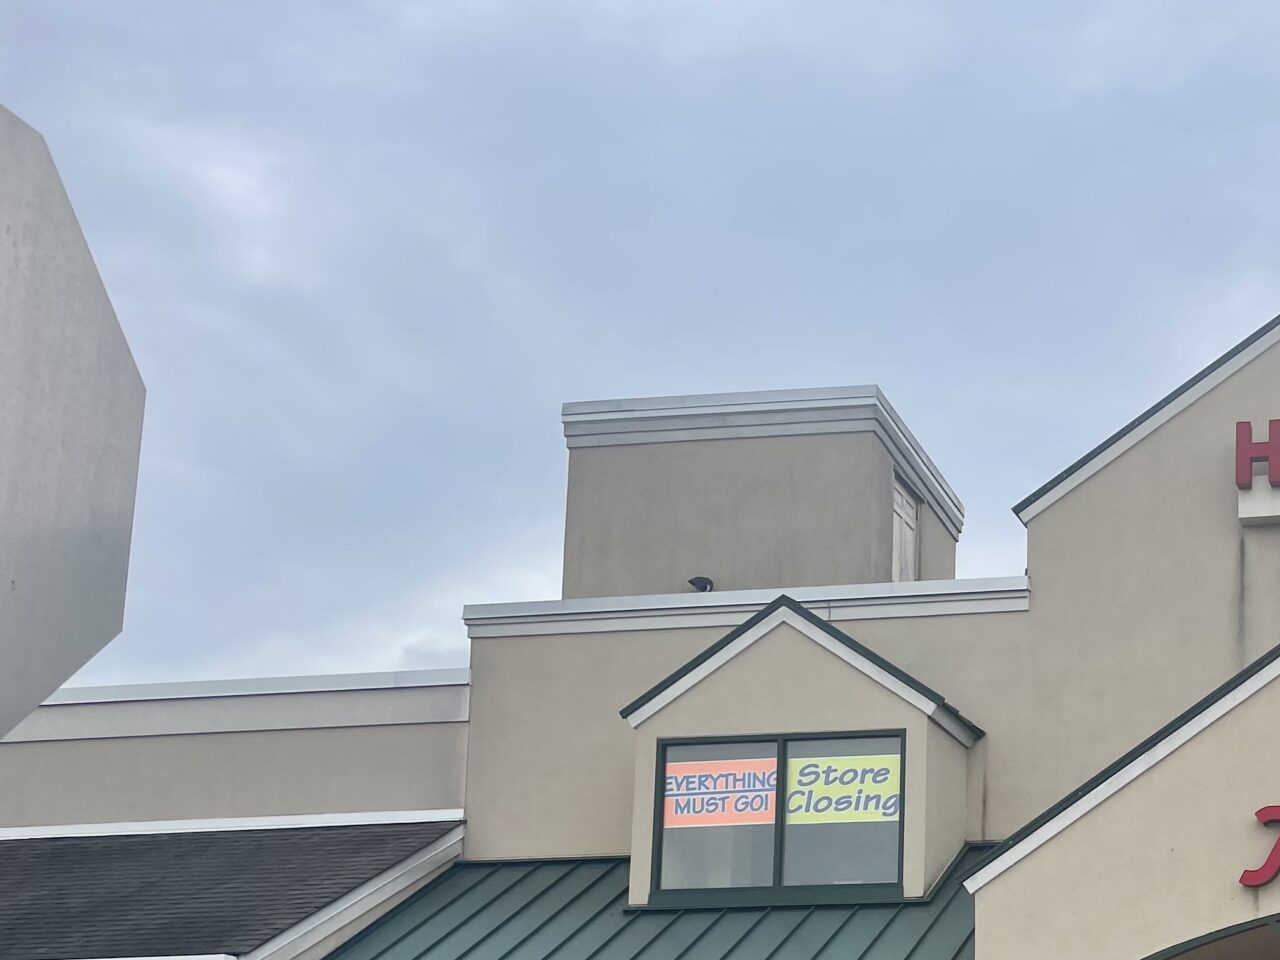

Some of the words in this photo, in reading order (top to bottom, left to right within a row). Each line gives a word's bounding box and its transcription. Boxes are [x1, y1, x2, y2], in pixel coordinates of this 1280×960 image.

[797, 763, 891, 786] Store
[674, 796, 730, 814] MUST
[786, 789, 900, 817] Closing
